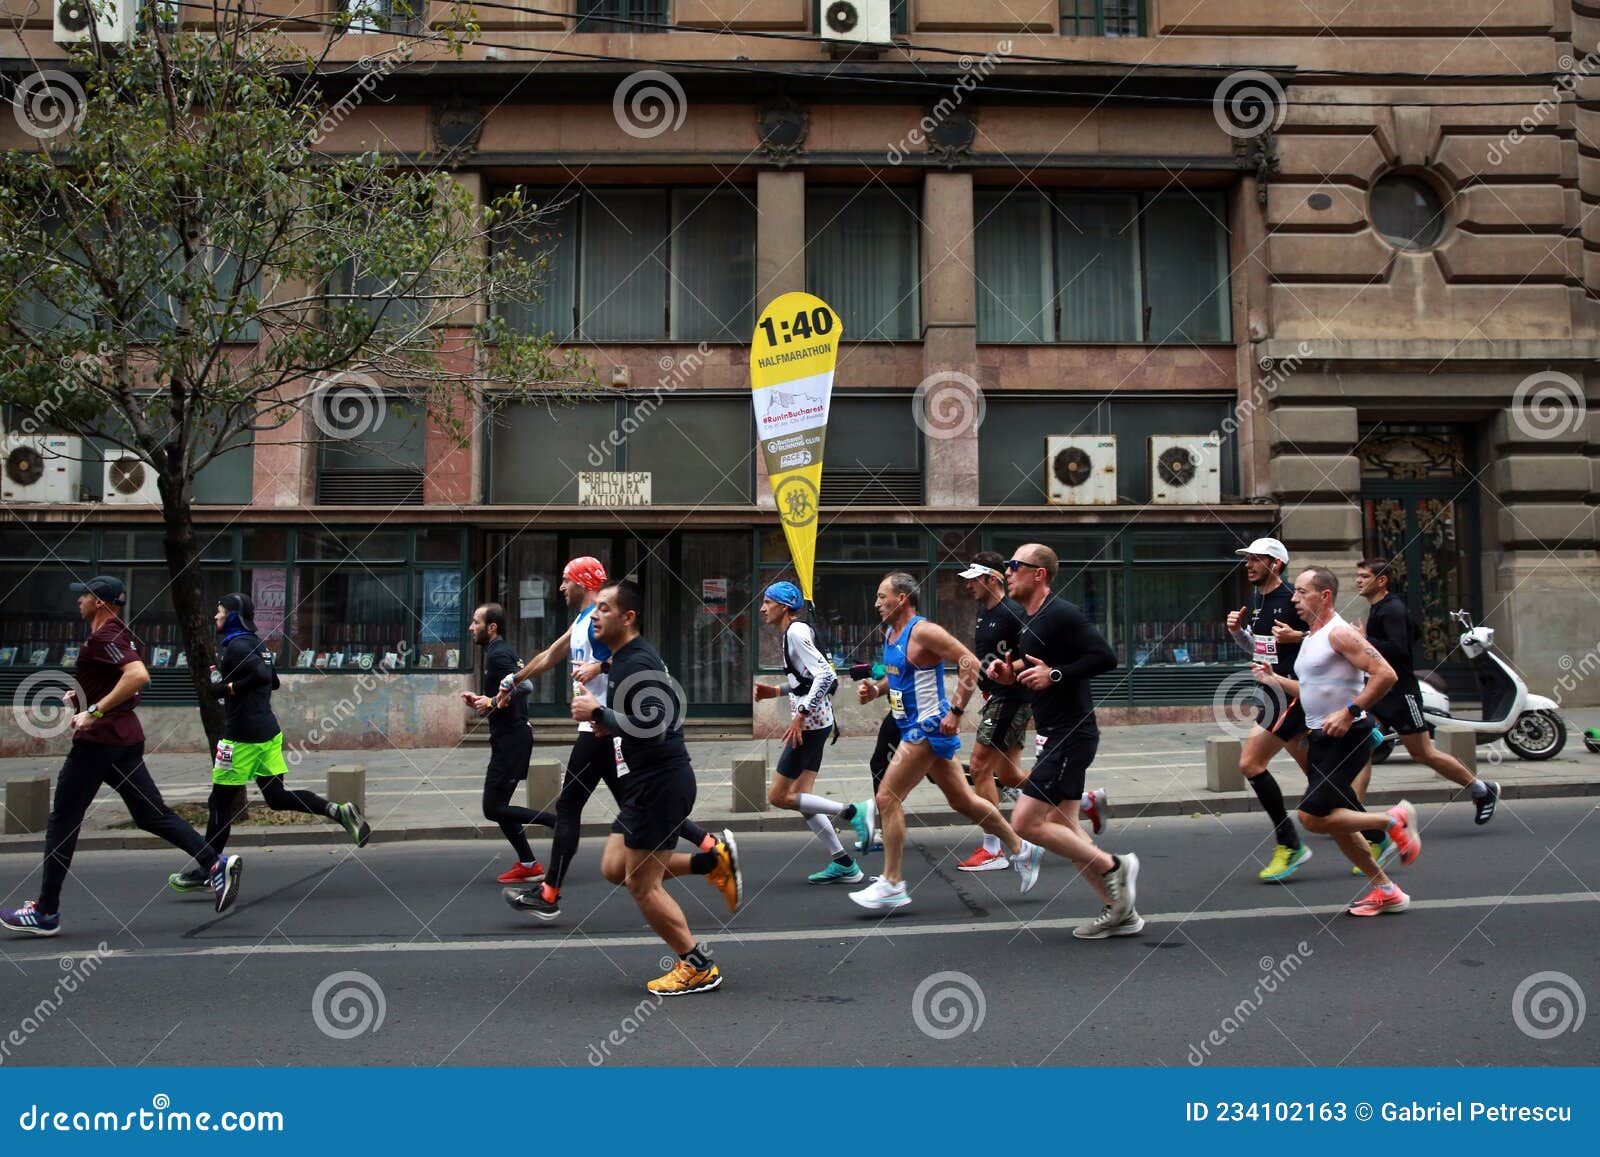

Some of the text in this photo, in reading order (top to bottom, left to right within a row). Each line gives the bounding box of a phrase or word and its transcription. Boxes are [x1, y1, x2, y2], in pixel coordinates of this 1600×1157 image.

[759, 306, 834, 347] 1:40
[758, 343, 831, 368] HALFMARATHON
[584, 472, 645, 483] BIBLIOTECA
